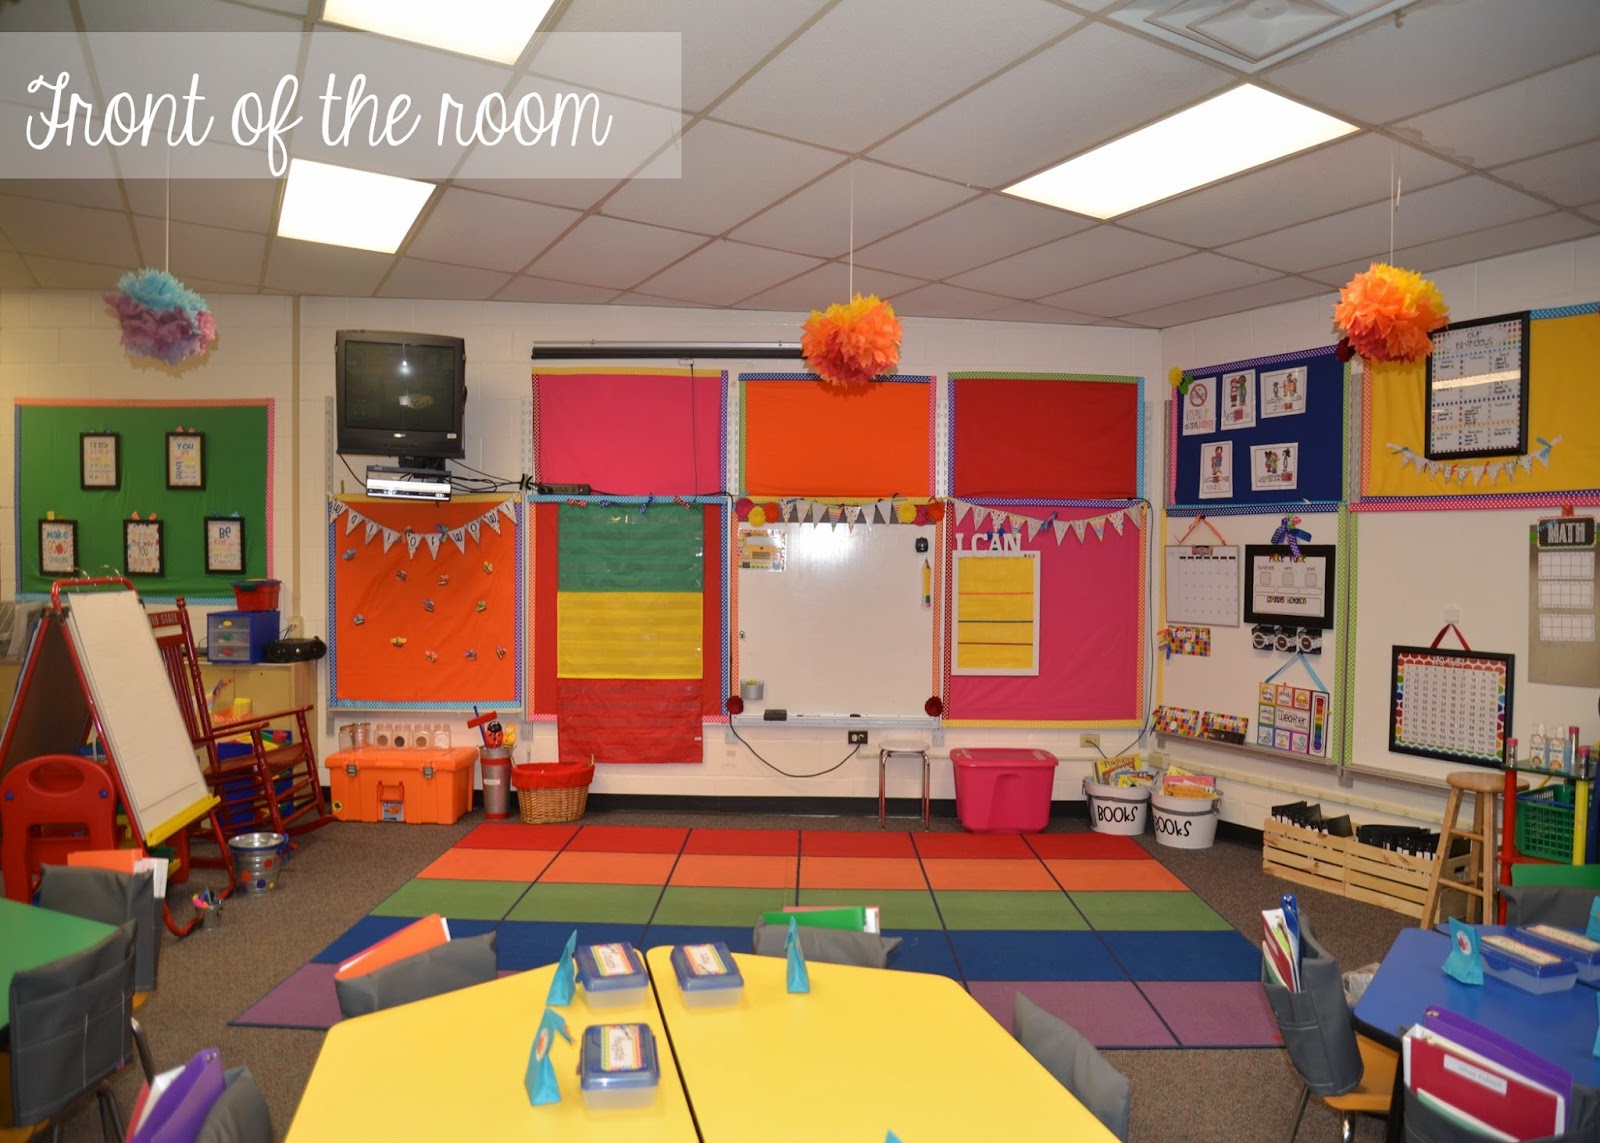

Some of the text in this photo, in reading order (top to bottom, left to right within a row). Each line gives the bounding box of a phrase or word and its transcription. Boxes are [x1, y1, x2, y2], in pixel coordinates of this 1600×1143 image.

[1547, 522, 1586, 544] MATH
[955, 533, 1022, 557] I CAN
[1170, 628, 1207, 643] Today is
[1162, 707, 1196, 724] Yesterday
[1209, 714, 1245, 728] Tomorrow
[1278, 712, 1307, 725] weather
